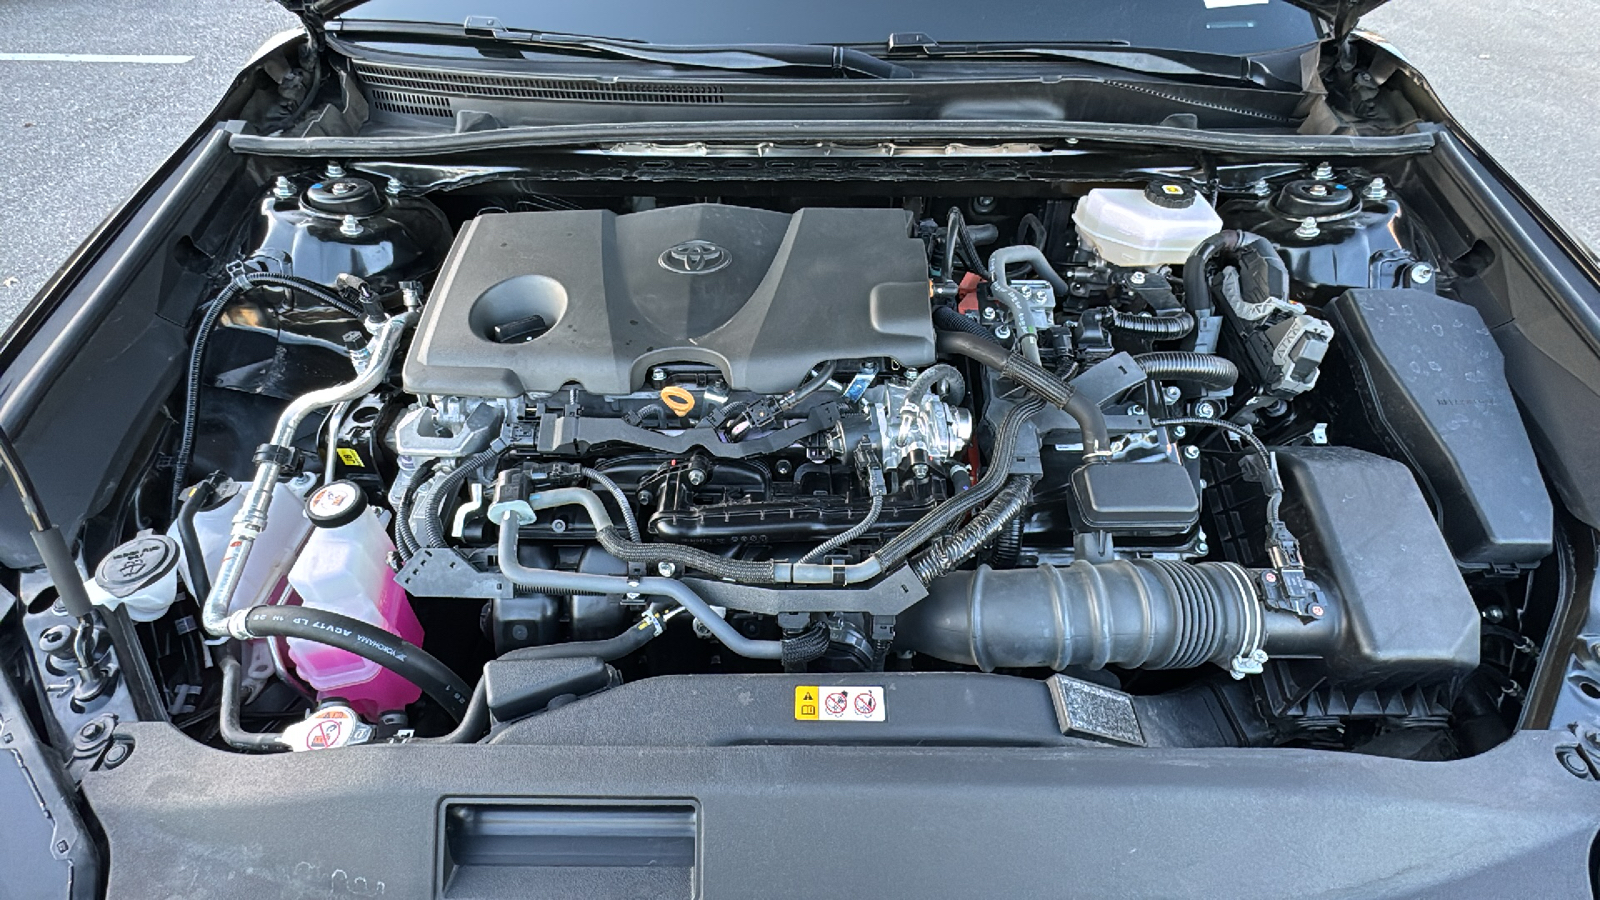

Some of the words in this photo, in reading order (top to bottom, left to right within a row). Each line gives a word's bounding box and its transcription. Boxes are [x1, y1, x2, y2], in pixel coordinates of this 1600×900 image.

[292, 617, 309, 626] LP
[312, 621, 353, 637] ACV17
[357, 634, 396, 657] YOKOHAMA
